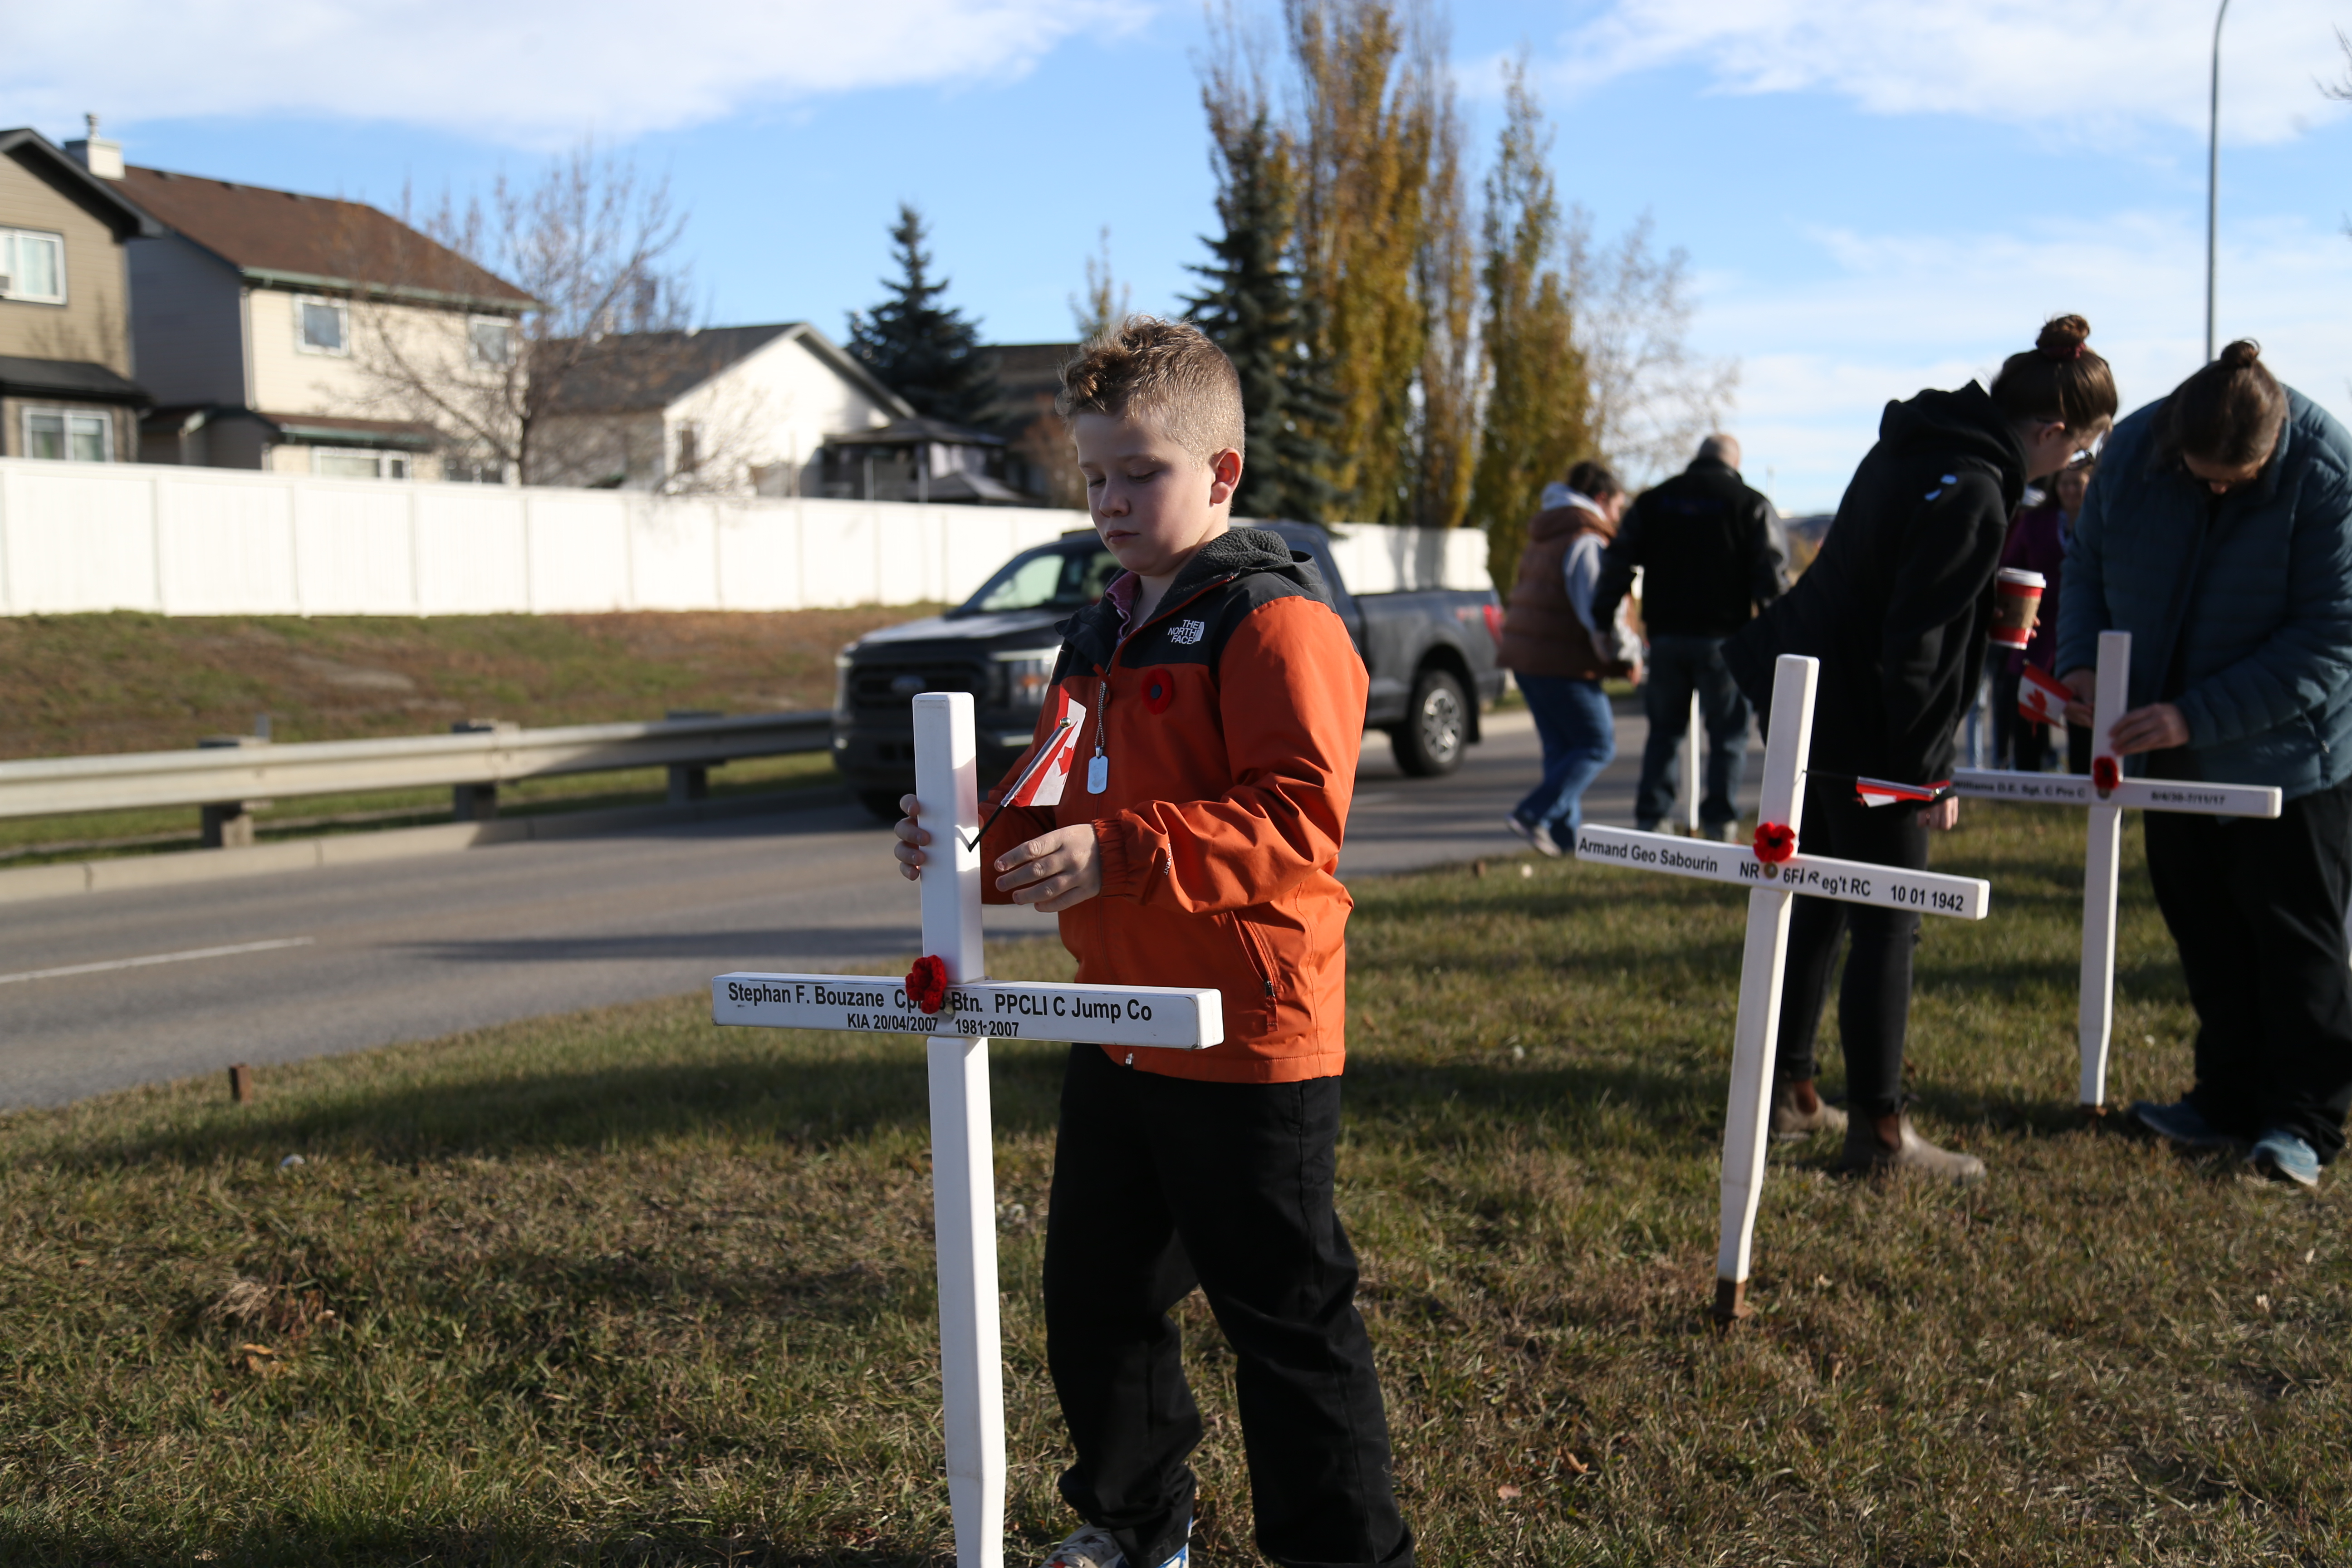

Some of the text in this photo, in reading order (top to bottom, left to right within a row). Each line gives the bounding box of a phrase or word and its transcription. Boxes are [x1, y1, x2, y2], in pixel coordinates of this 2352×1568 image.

[1167, 627, 1196, 637] NORTH
[1183, 620, 1200, 629] THE
[1171, 635, 1194, 644] FACE
[1579, 838, 1627, 858] Armand
[1631, 845, 1656, 863] Geo
[1661, 849, 1718, 873] Sabourin
[1740, 861, 1759, 879] NR
[1851, 878, 1871, 897] RC
[1891, 884, 1906, 902] 10
[1910, 888, 1925, 906] 01
[1931, 891, 1964, 911] 1942
[728, 982, 791, 1006] Stephan
[796, 985, 810, 1004] F.
[815, 985, 884, 1007] Bouzane
[951, 991, 983, 1012] Btn.
[995, 993, 1048, 1016] PPCLI
[1053, 996, 1066, 1017] C
[1071, 997, 1122, 1024] Jump
[1127, 999, 1152, 1021] Co
[847, 1013, 1019, 1037] KIA 20/04/2007 1981-2007
